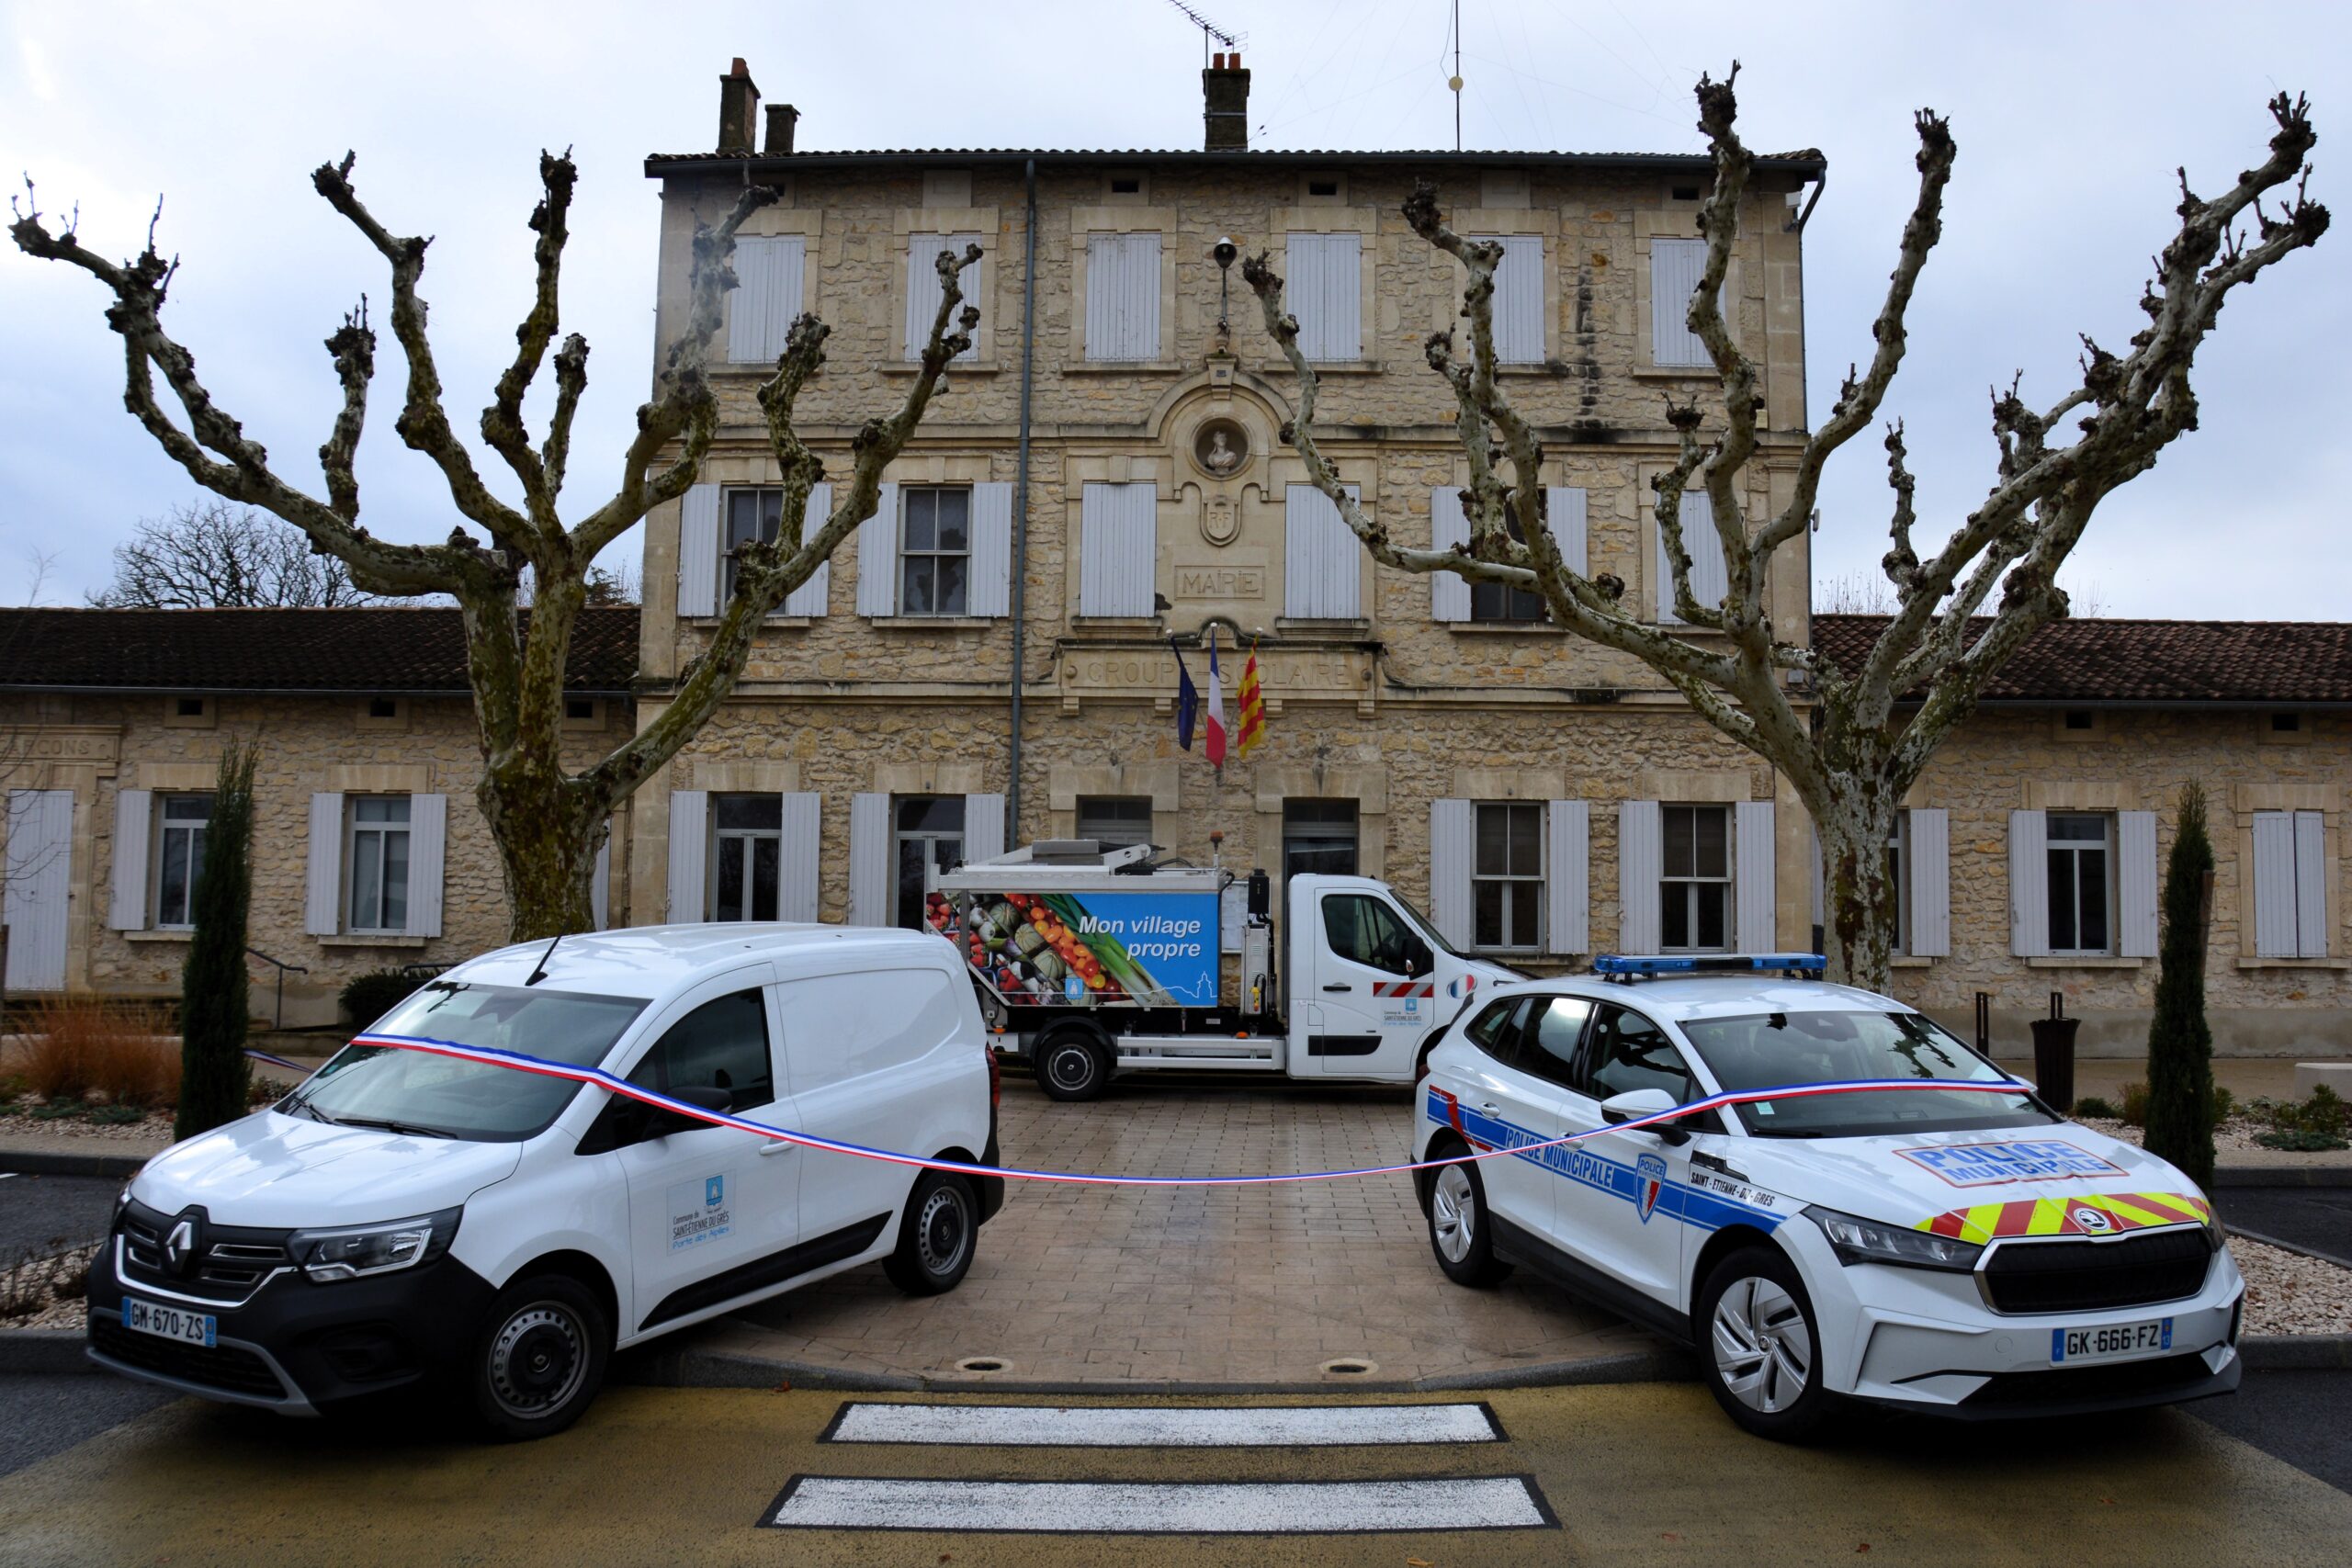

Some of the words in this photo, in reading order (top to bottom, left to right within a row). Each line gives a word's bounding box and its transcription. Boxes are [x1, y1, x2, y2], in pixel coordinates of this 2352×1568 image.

[1087, 661, 1193, 683] GROUP
[1079, 916, 1125, 933] Mon
[1131, 916, 1201, 938] village
[1126, 942, 1201, 961] propre
[1506, 1129, 1542, 1160] POLICE
[1544, 1145, 1613, 1188] MUNICIPALE
[1640, 1158, 1664, 1176] POLICE
[1909, 1142, 2087, 1168] POLICE
[1943, 1158, 2112, 1181] MUNICIPALE
[1690, 1172, 1710, 1188] SAINT
[1712, 1179, 1738, 1195] ETIENNE
[1753, 1192, 1775, 1207] GRES
[131, 1303, 204, 1340] GM-670-ZS
[2067, 1325, 2159, 1356] GK-666-FZ
